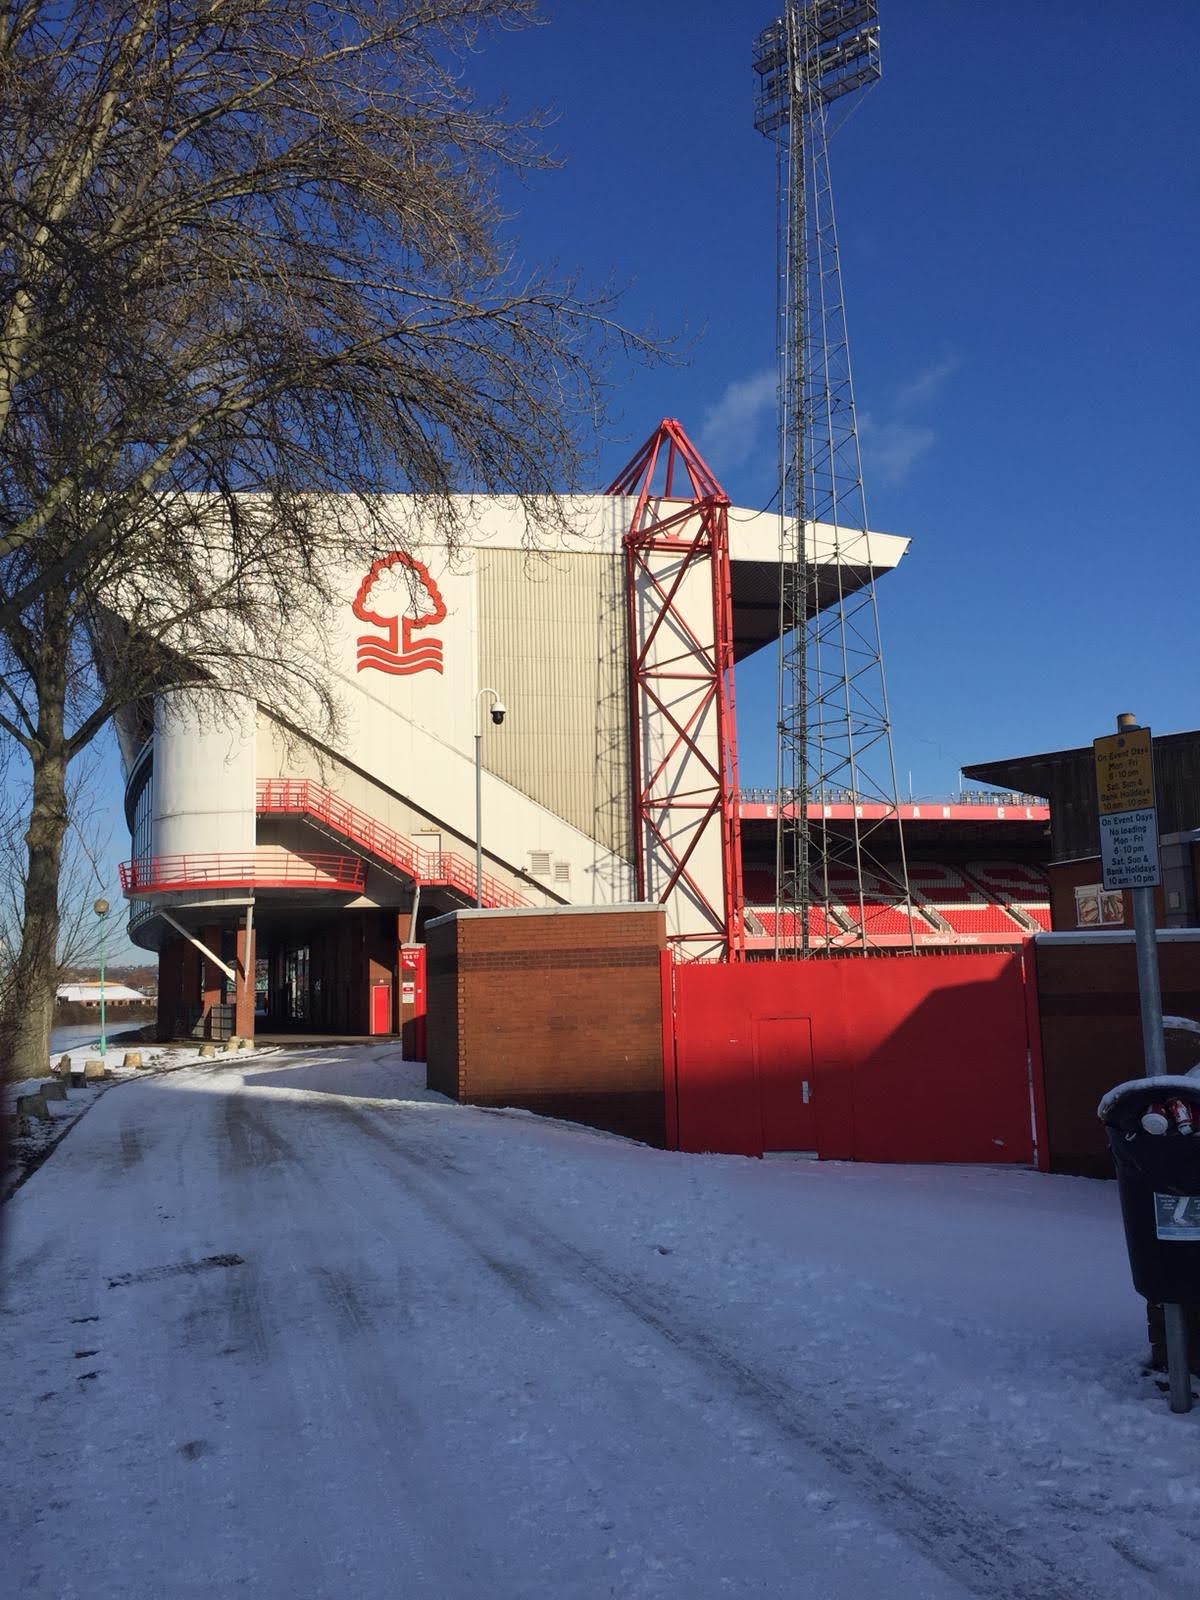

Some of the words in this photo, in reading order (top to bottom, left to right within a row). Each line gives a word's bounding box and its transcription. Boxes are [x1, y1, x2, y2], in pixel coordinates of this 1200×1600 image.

[1109, 751, 1128, 760] Event
[1102, 818, 1111, 826] On
[1113, 815, 1133, 824] Event
[1136, 813, 1153, 822] Days
[1114, 837, 1129, 845] Mon
[1124, 845, 1132, 853] 10
[1133, 845, 1144, 854] pm
[1128, 855, 1142, 863] Sun
[1144, 854, 1148, 862] &
[1106, 867, 1123, 875] Bank
[1126, 863, 1156, 874] Holidays
[1109, 877, 1116, 885] 10
[1133, 874, 1142, 883] 10
[1143, 875, 1155, 883] pm
